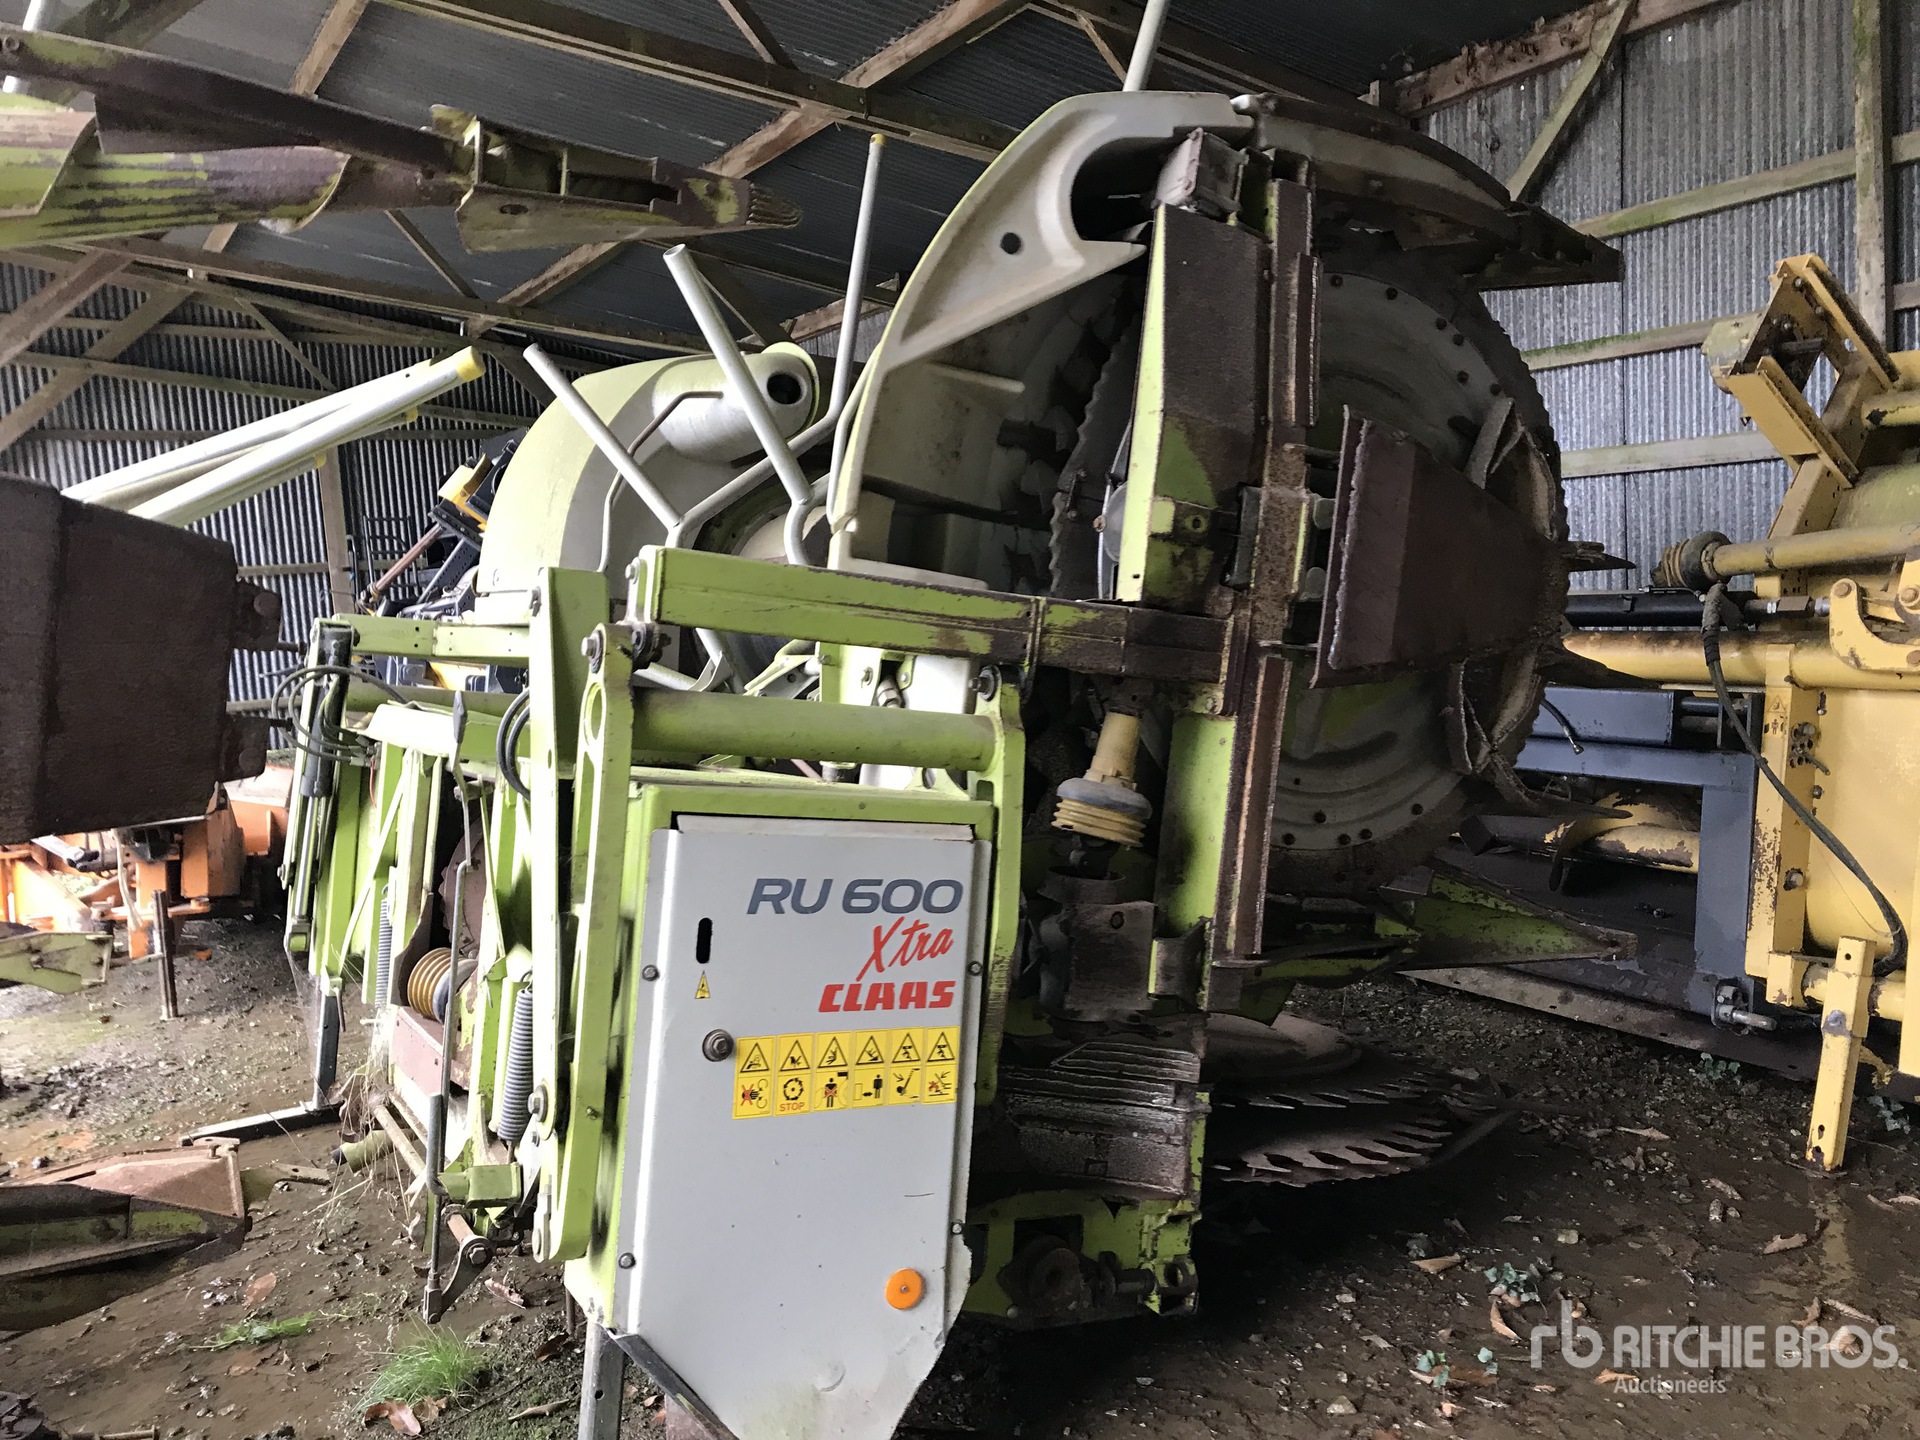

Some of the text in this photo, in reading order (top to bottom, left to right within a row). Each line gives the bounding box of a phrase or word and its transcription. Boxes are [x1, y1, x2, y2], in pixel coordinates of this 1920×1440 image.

[746, 878, 964, 914] RU 600
[856, 916, 954, 982] Xtra
[818, 980, 956, 1012] CLAAS
[779, 1101, 805, 1112] STOP
